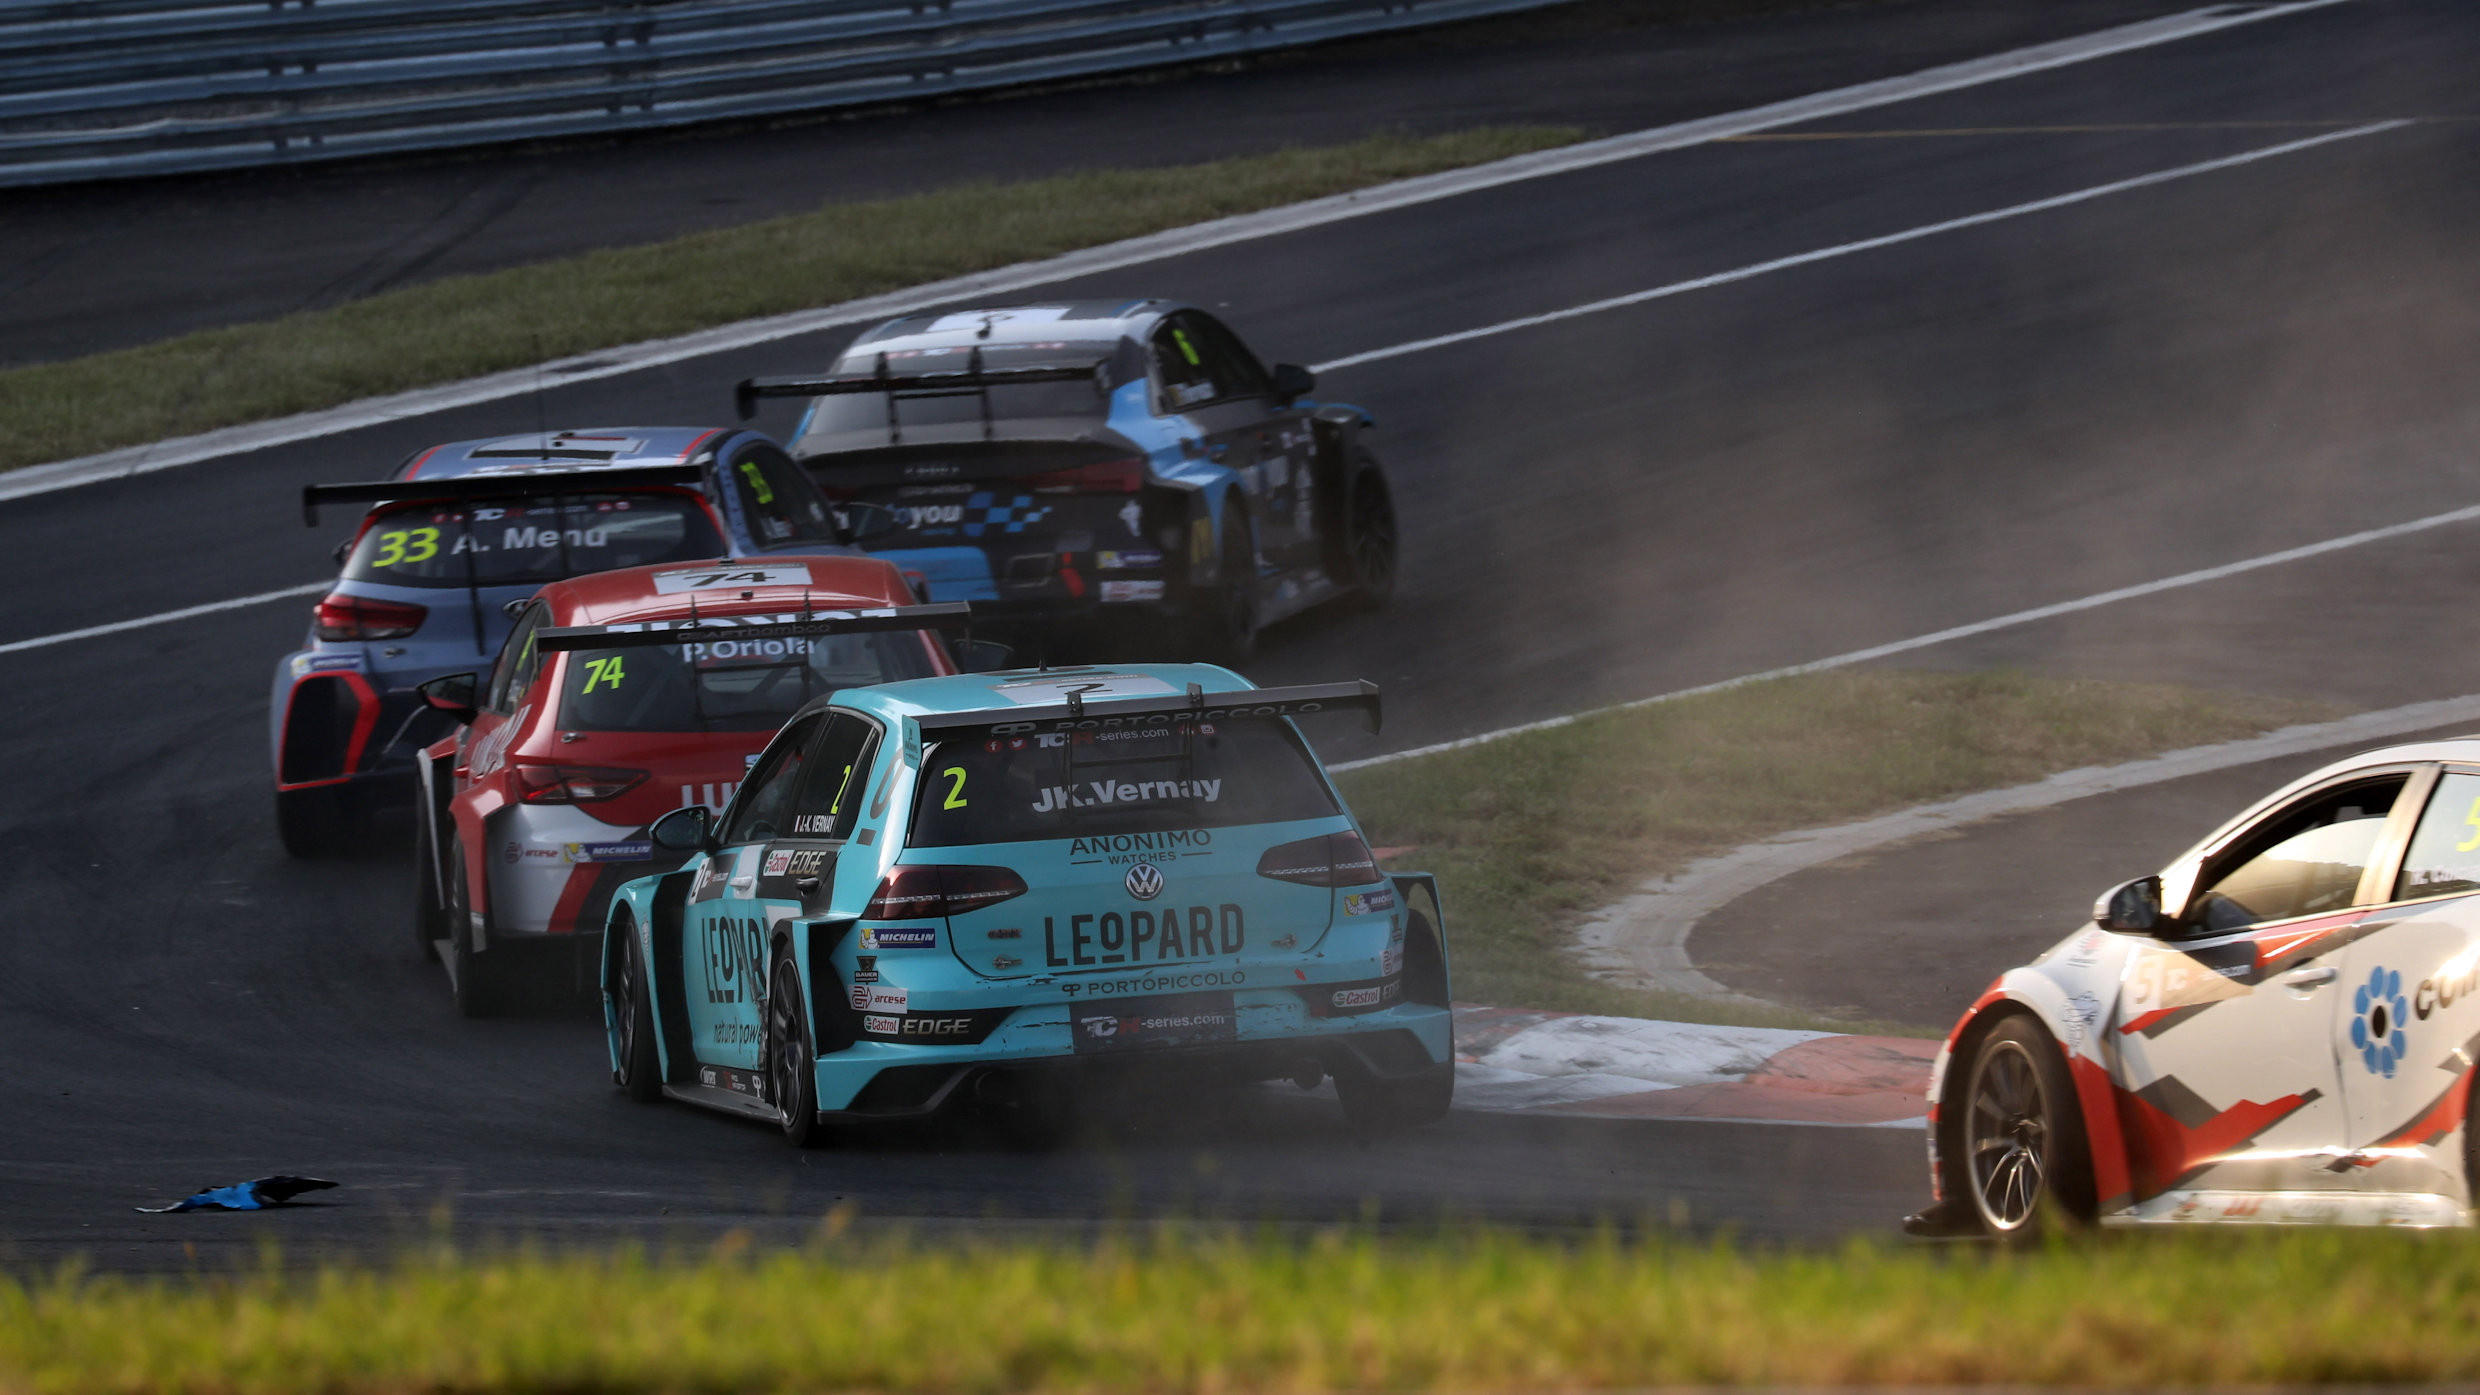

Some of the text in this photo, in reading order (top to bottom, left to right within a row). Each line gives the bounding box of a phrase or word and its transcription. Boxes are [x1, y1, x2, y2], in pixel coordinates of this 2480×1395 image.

[372, 527, 440, 568] 33
[450, 525, 609, 555] A. Menu
[582, 656, 625, 694] 74
[831, 765, 851, 814] 2
[943, 766, 968, 810] 2
[1032, 778, 1222, 813] JK.Vernay
[812, 815, 837, 833] VERNAY
[592, 845, 651, 855] MICHELIN
[1070, 829, 1212, 856] ANONIMO
[788, 851, 827, 875] EDGE
[1109, 850, 1177, 865] WATCHES
[879, 932, 935, 942] MICHELIN
[1044, 903, 1245, 967] LEOPARD
[1088, 971, 1246, 995] PORTOPICCOLO
[874, 994, 906, 1004] arcese
[1345, 989, 1379, 1005] Castrol
[872, 1017, 973, 1035] Castrol EDGE
[739, 1023, 764, 1055] powe
